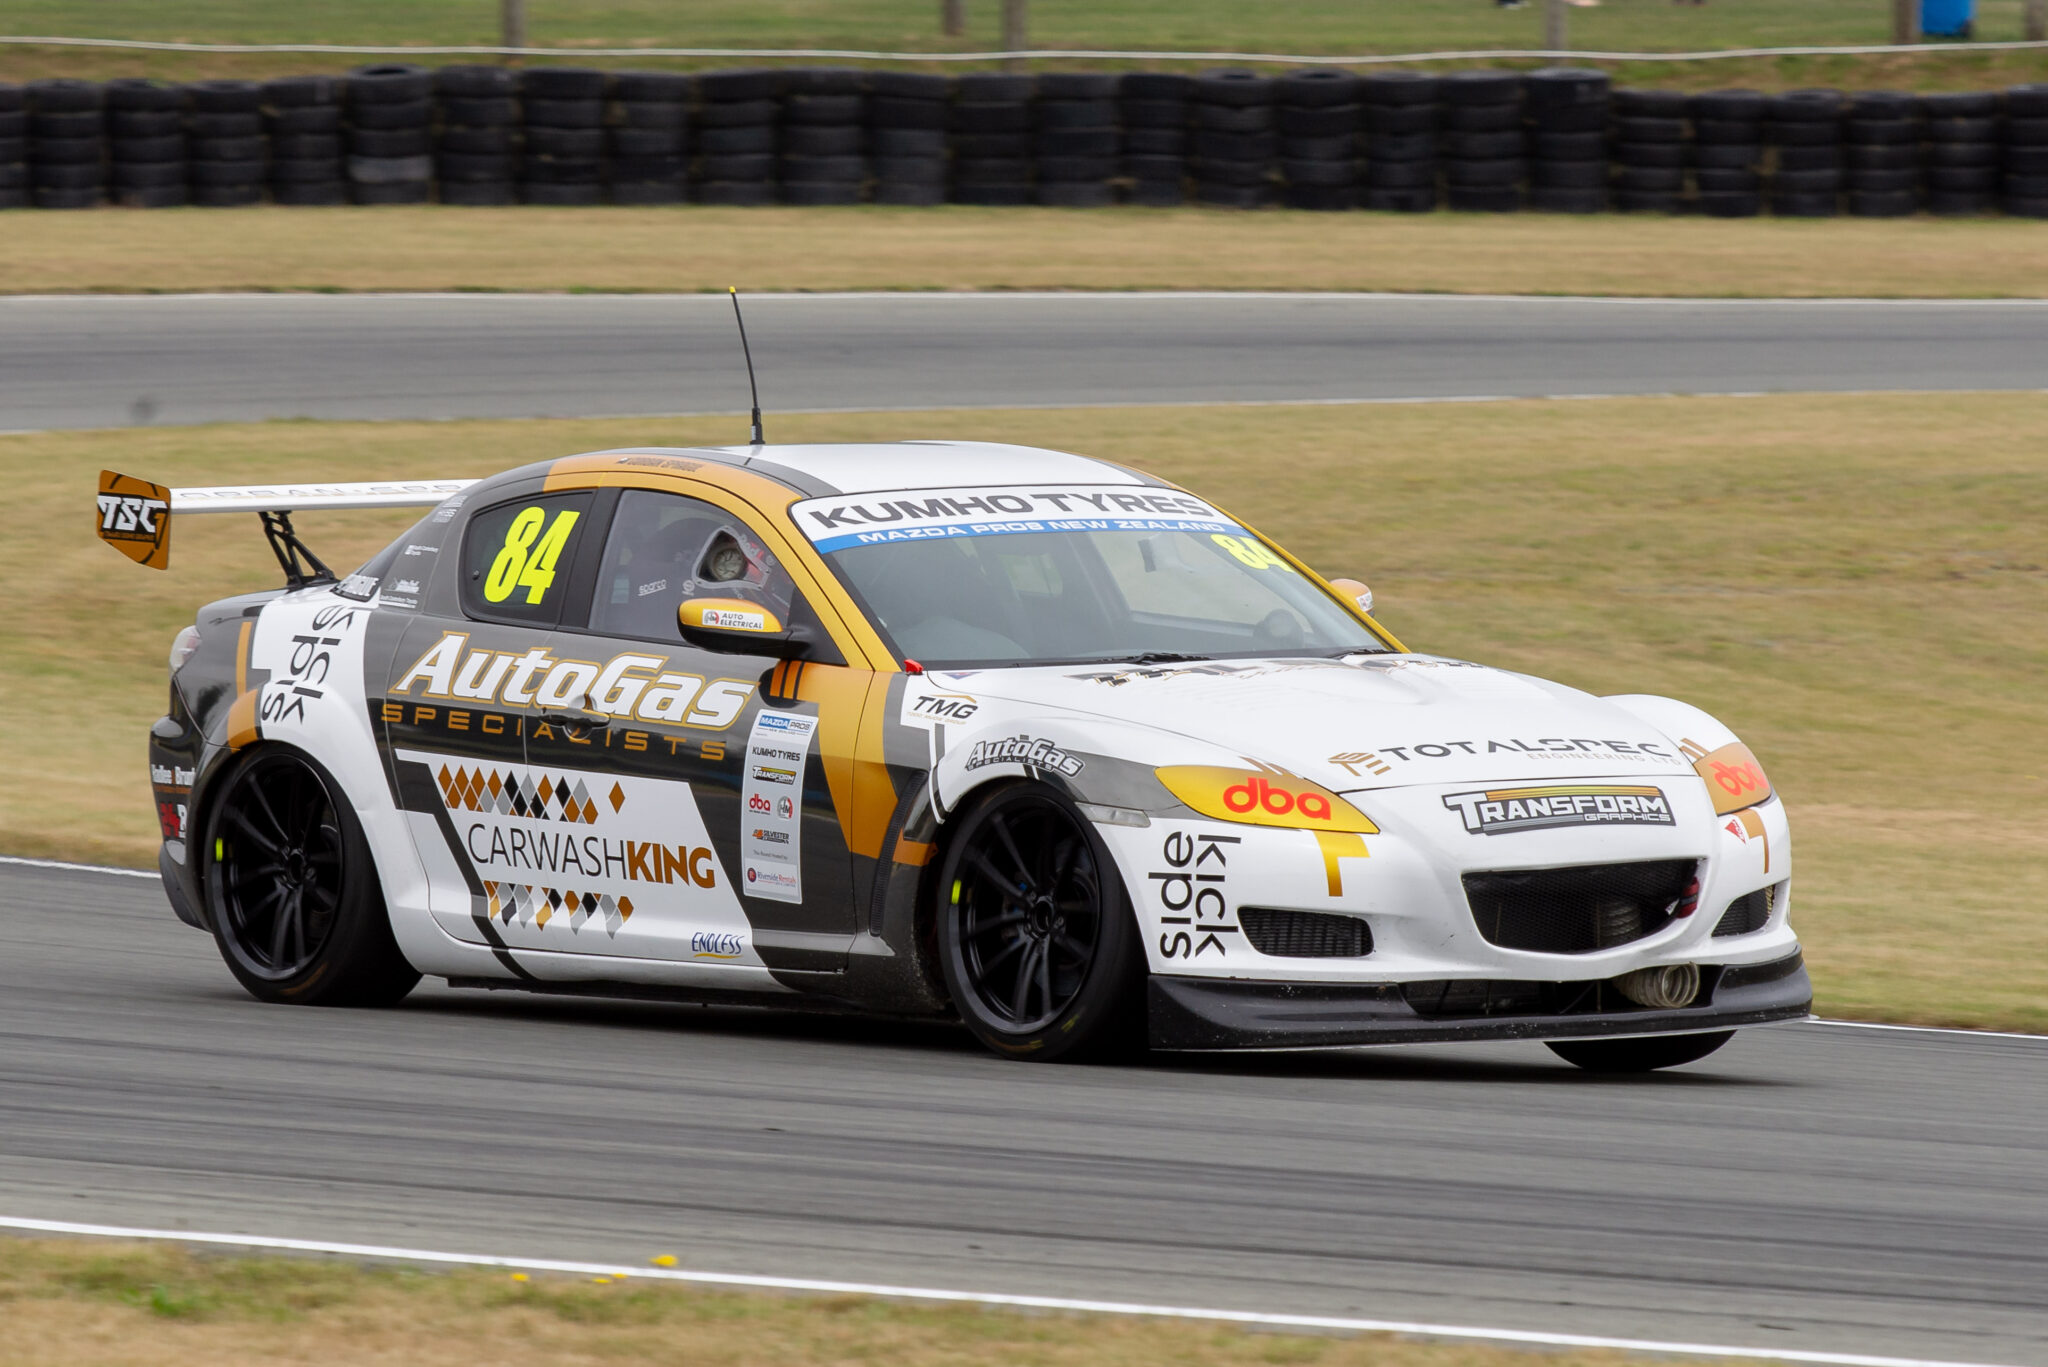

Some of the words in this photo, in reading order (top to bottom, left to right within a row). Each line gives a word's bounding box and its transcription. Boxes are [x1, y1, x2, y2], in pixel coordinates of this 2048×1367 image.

[808, 494, 1034, 529] KUMHO
[1030, 493, 1215, 518] TYRES
[856, 525, 967, 543] MAZDA
[970, 521, 1045, 534] PROS
[1049, 520, 1109, 531] NEW
[1113, 519, 1225, 533] ZEALAND
[483, 505, 581, 605] 84
[1210, 533, 1296, 574] 84
[719, 619, 763, 630] ELECTRICAL
[721, 612, 744, 621] AUTO
[388, 631, 759, 731] AutoGas
[913, 695, 979, 720] TMG
[380, 703, 728, 761] SPECIALISTS
[760, 715, 789, 728] MAZDA
[790, 721, 811, 731] PROS
[752, 746, 777, 758] KUMHO
[777, 750, 801, 762] TYRES
[966, 737, 1086, 778] AutoGas
[1378, 737, 1673, 762] TOTALSPEC
[1527, 752, 1647, 763] ENGINEERING
[1648, 756, 1682, 766] LTD
[753, 766, 795, 782] TRANSFORM
[968, 756, 1056, 772] SPECIALISTS
[1708, 759, 1770, 797] dba
[748, 793, 771, 811] dba
[1222, 776, 1332, 821] dba
[1443, 792, 1670, 831] TRANSFORM
[1583, 812, 1672, 823] GRAPHICS
[763, 829, 790, 840] SILVESTER
[467, 822, 717, 889] CARWASHKING
[1148, 831, 1194, 960] side
[1194, 834, 1242, 957] kick
[691, 931, 745, 955] ENDLESS
